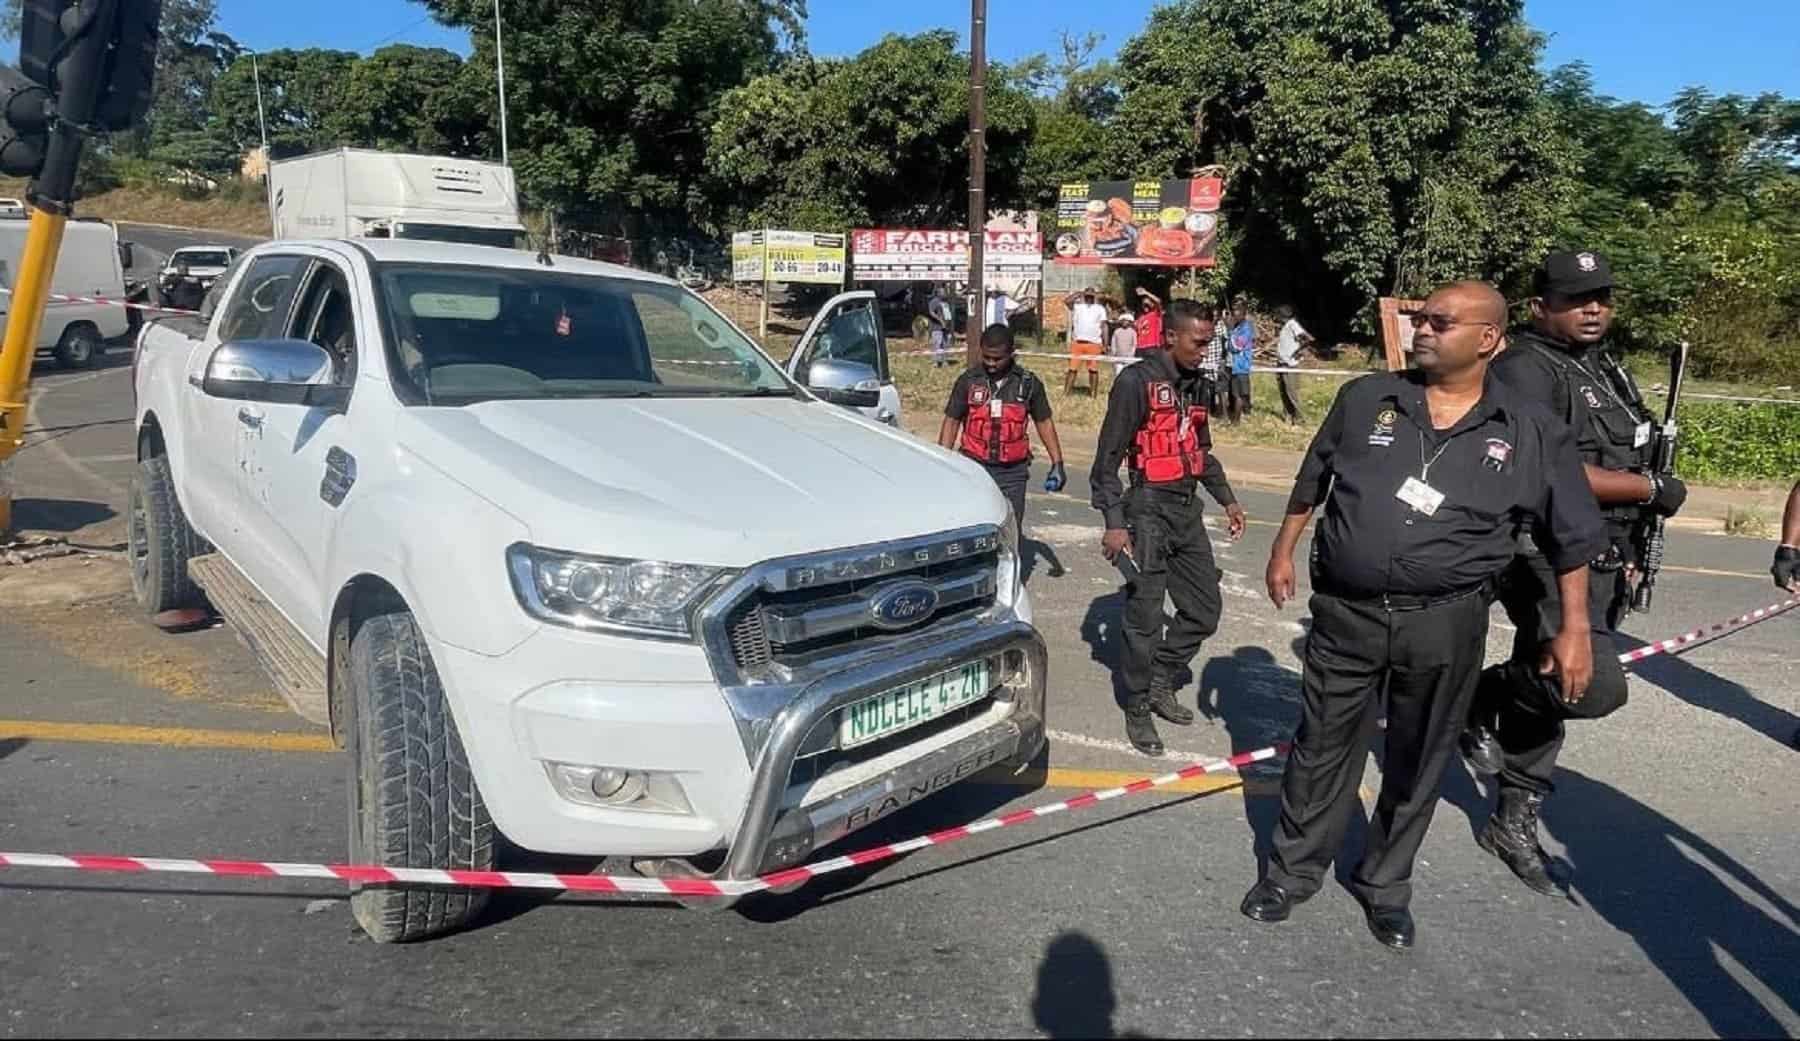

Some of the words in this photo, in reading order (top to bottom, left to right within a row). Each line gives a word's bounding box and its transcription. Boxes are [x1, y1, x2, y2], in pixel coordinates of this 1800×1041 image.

[891, 597, 927, 618] Ford
[851, 682, 931, 739] NDLELE
[939, 675, 948, 708] 4
[960, 662, 982, 700] ZN
[847, 749, 995, 831] RANGER
